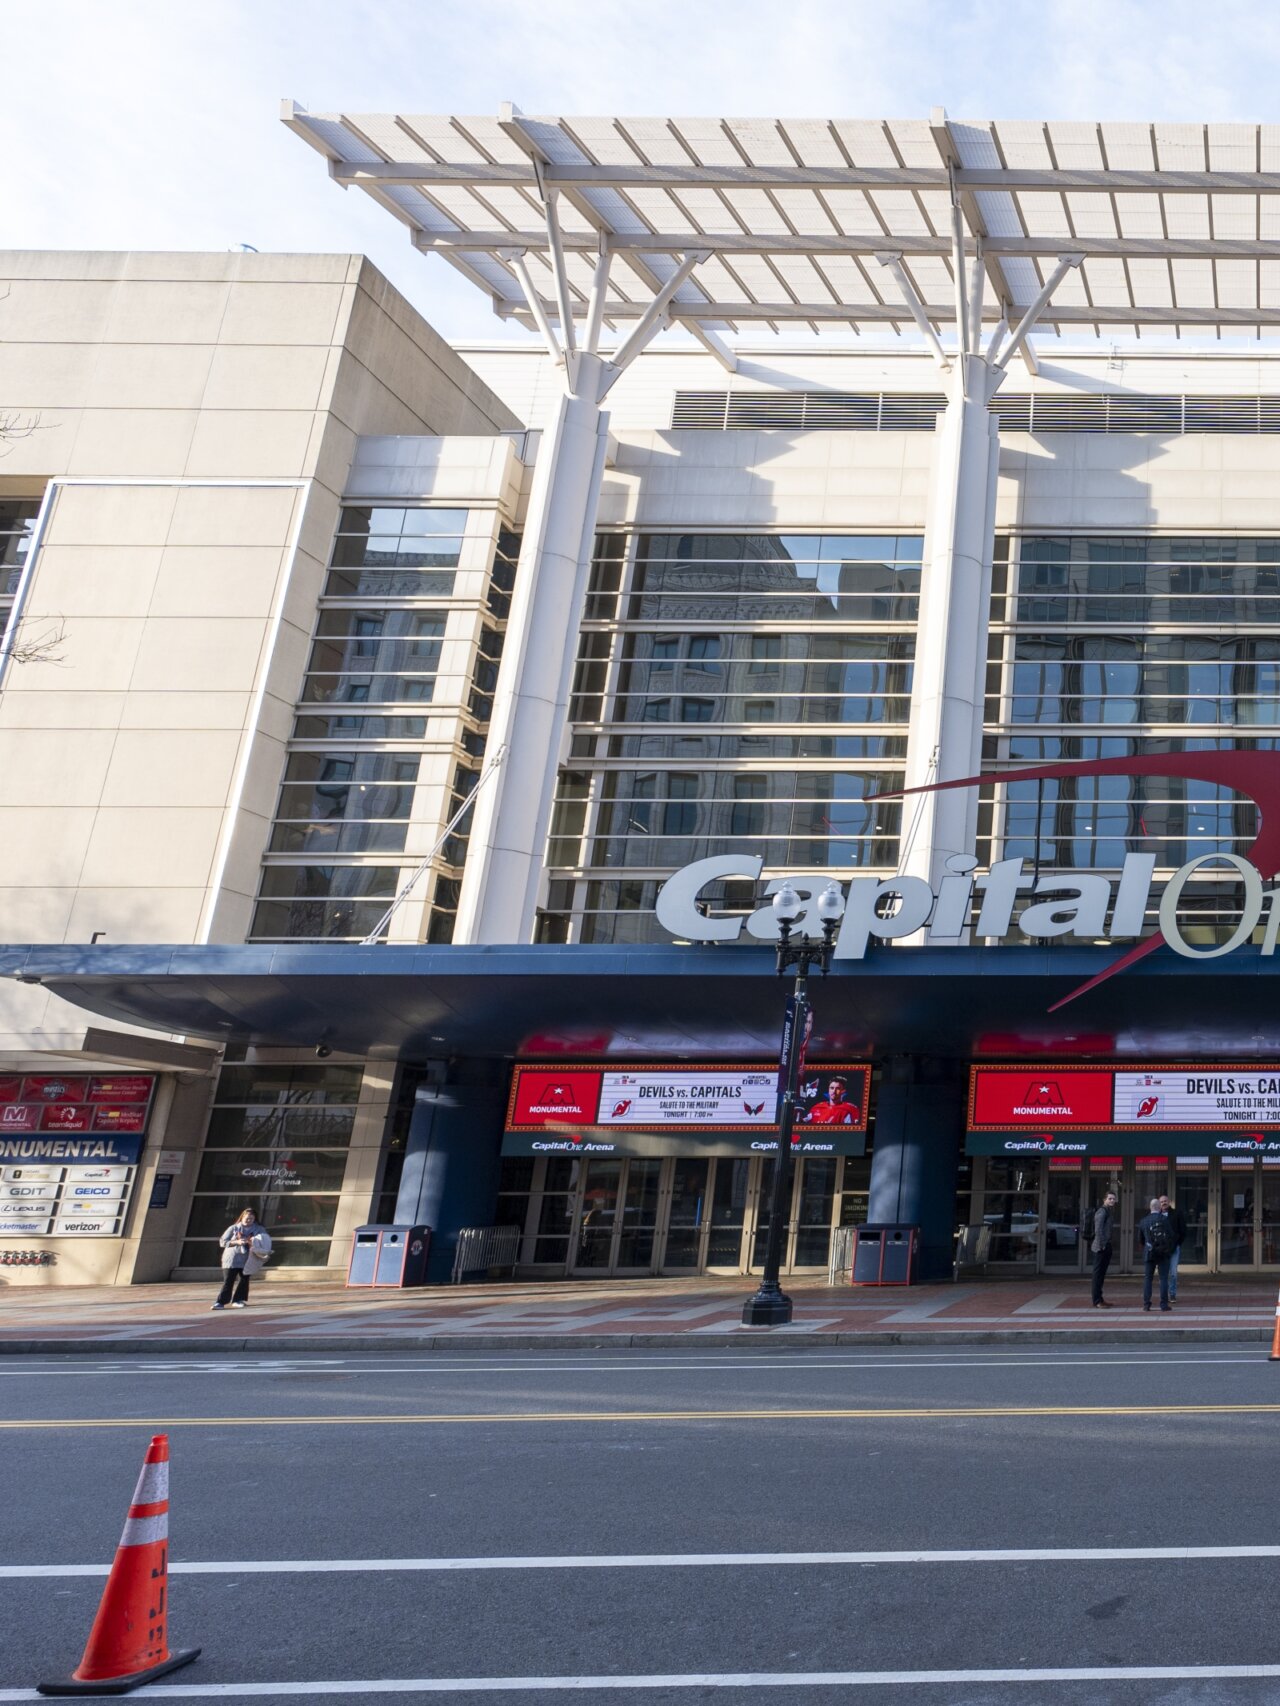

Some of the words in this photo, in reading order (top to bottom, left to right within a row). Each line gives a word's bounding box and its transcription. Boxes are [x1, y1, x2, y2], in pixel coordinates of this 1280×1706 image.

[1186, 1079, 1235, 1094] DEVILS
[639, 1086, 674, 1098] DEVILS
[690, 1086, 742, 1098] CAPITALS
[659, 1101, 678, 1109] SALUTE
[678, 1101, 685, 1109] TO
[686, 1101, 695, 1109] THE
[696, 1101, 719, 1109] MILITARY
[1216, 1098, 1241, 1108] SALUTE
[1243, 1098, 1251, 1108] TO
[1253, 1098, 1265, 1108] THE
[1013, 1107, 1072, 1115] MONUMENTAL
[1223, 1111, 1257, 1120] TONIGHT
[584, 1143, 615, 1151] Arena
[803, 1143, 833, 1151] Arena
[10, 1187, 46, 1196] GDIT
[75, 1187, 110, 1195] GEICO
[65, 1222, 100, 1231] verizon
